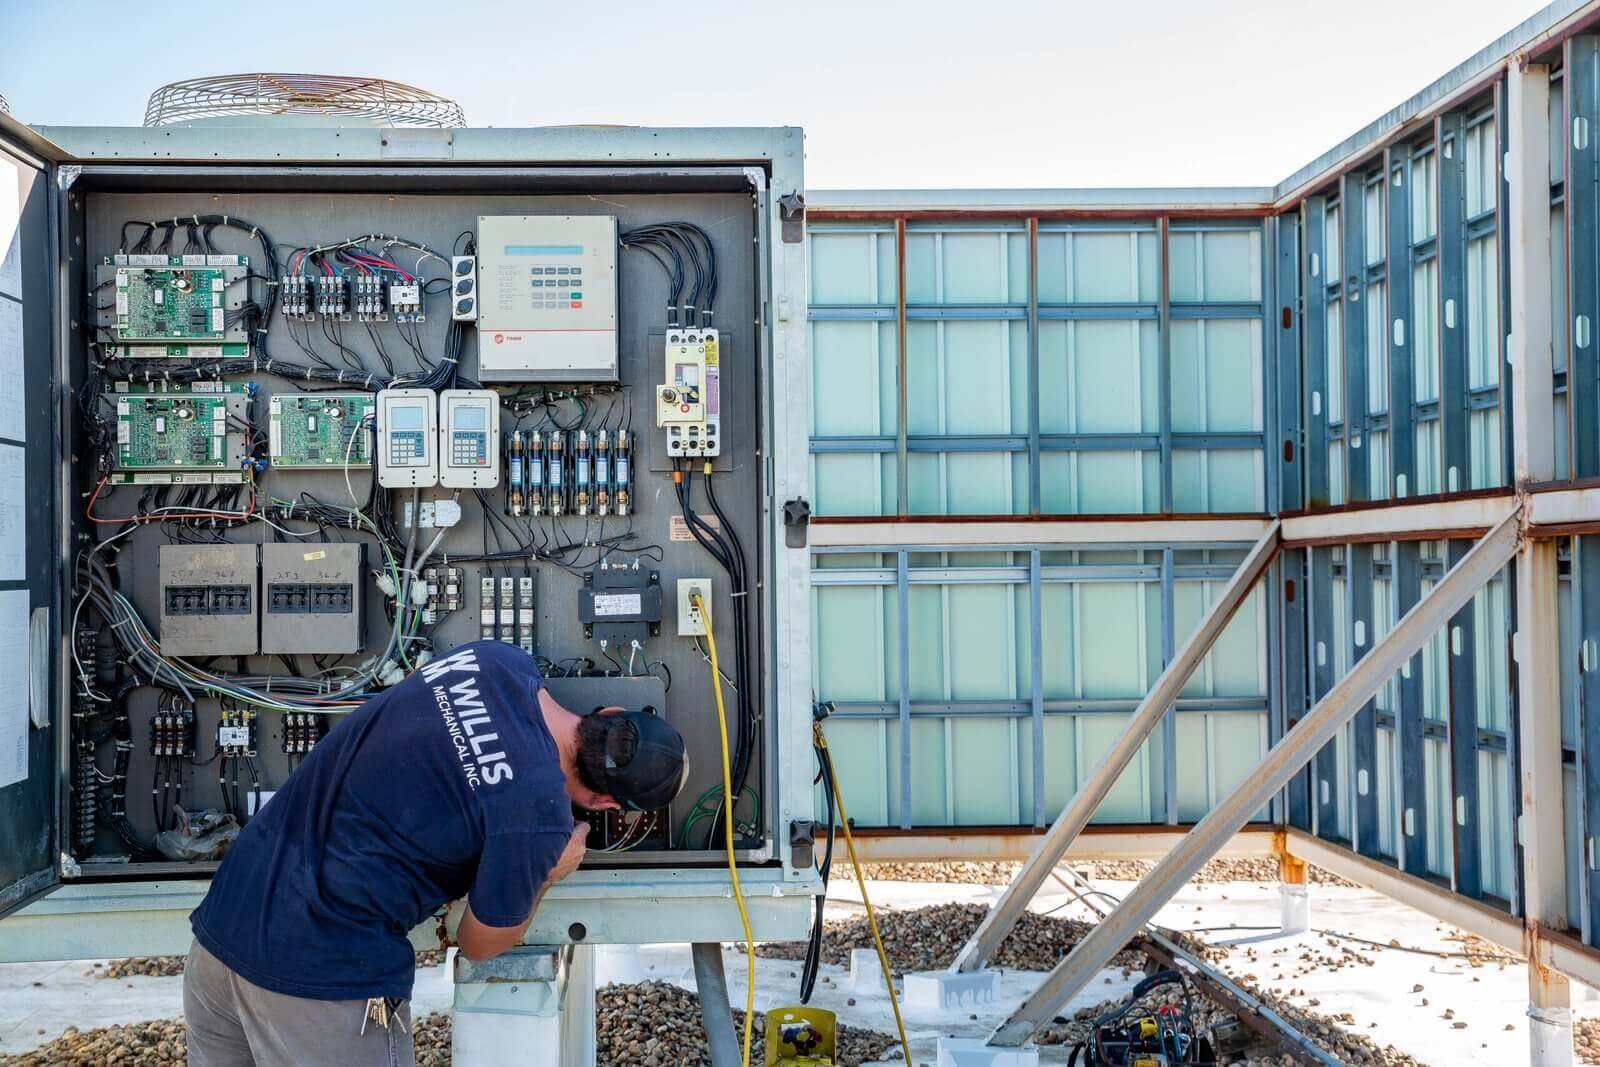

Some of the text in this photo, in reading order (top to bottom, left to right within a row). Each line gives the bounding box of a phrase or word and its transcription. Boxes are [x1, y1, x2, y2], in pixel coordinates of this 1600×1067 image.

[432, 685, 481, 791] MECHANICAL INC.
[449, 677, 513, 785] WILLIS
